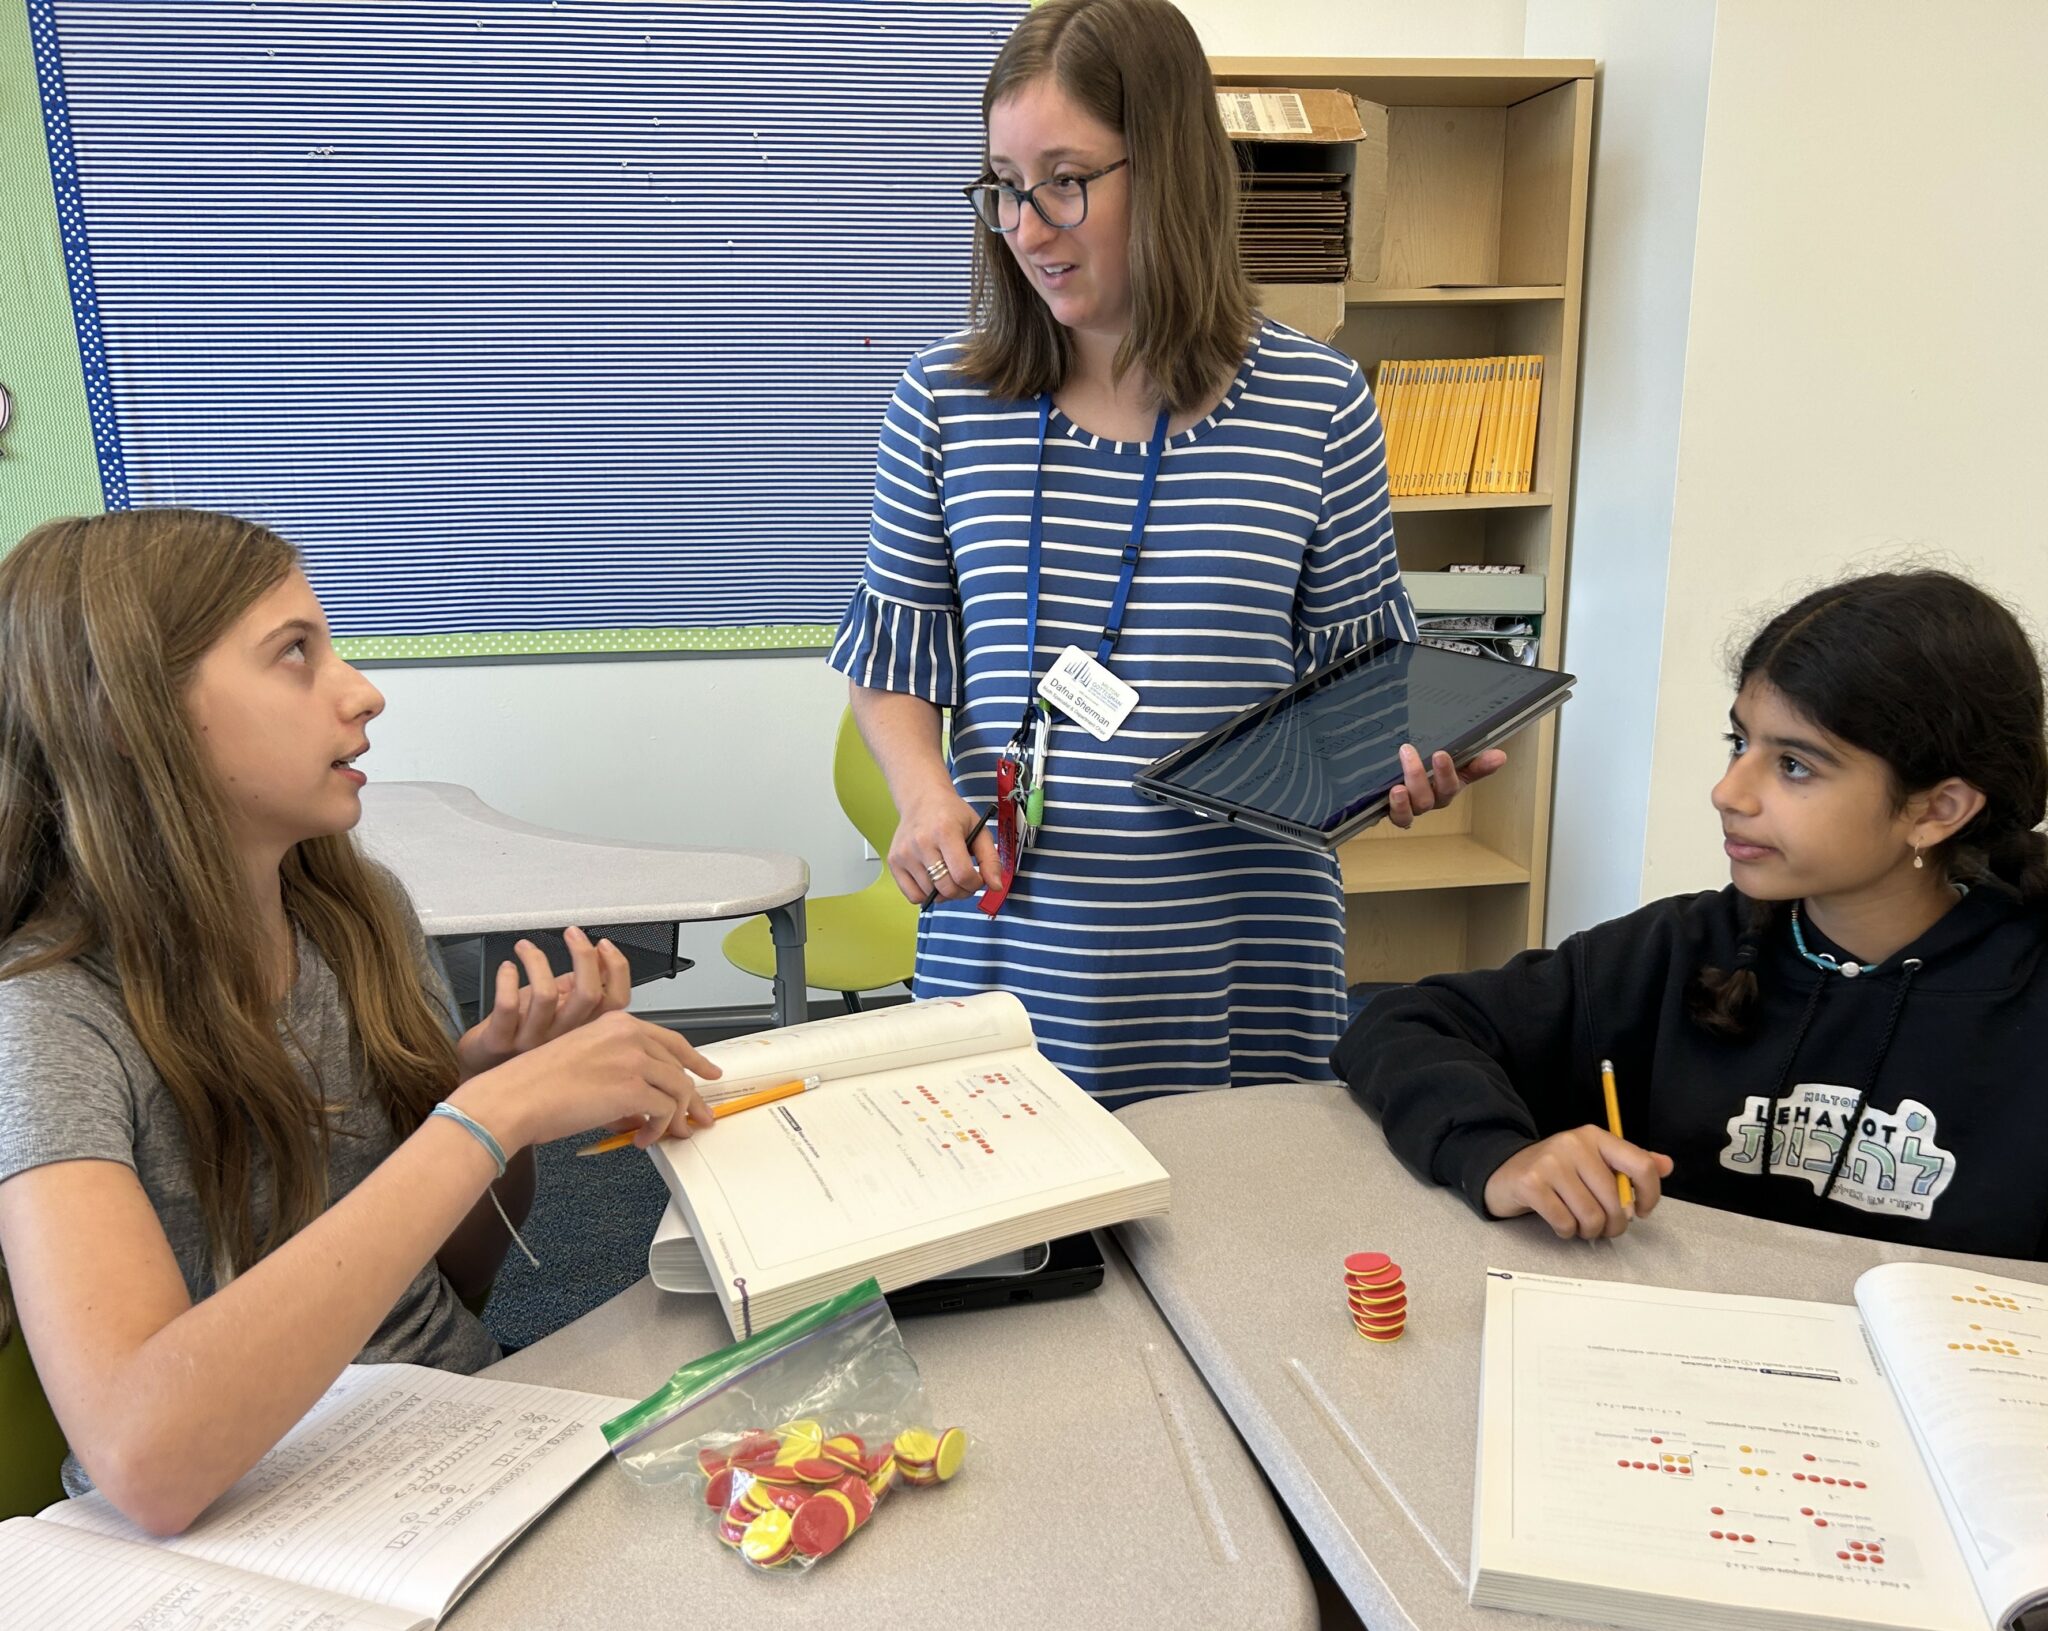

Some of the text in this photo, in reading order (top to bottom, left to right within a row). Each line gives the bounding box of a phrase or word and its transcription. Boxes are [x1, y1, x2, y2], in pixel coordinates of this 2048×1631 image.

[1049, 677, 1074, 700] Dafna
[1075, 695, 1110, 728] Sherman
[438, 1499, 486, 1526] signs
